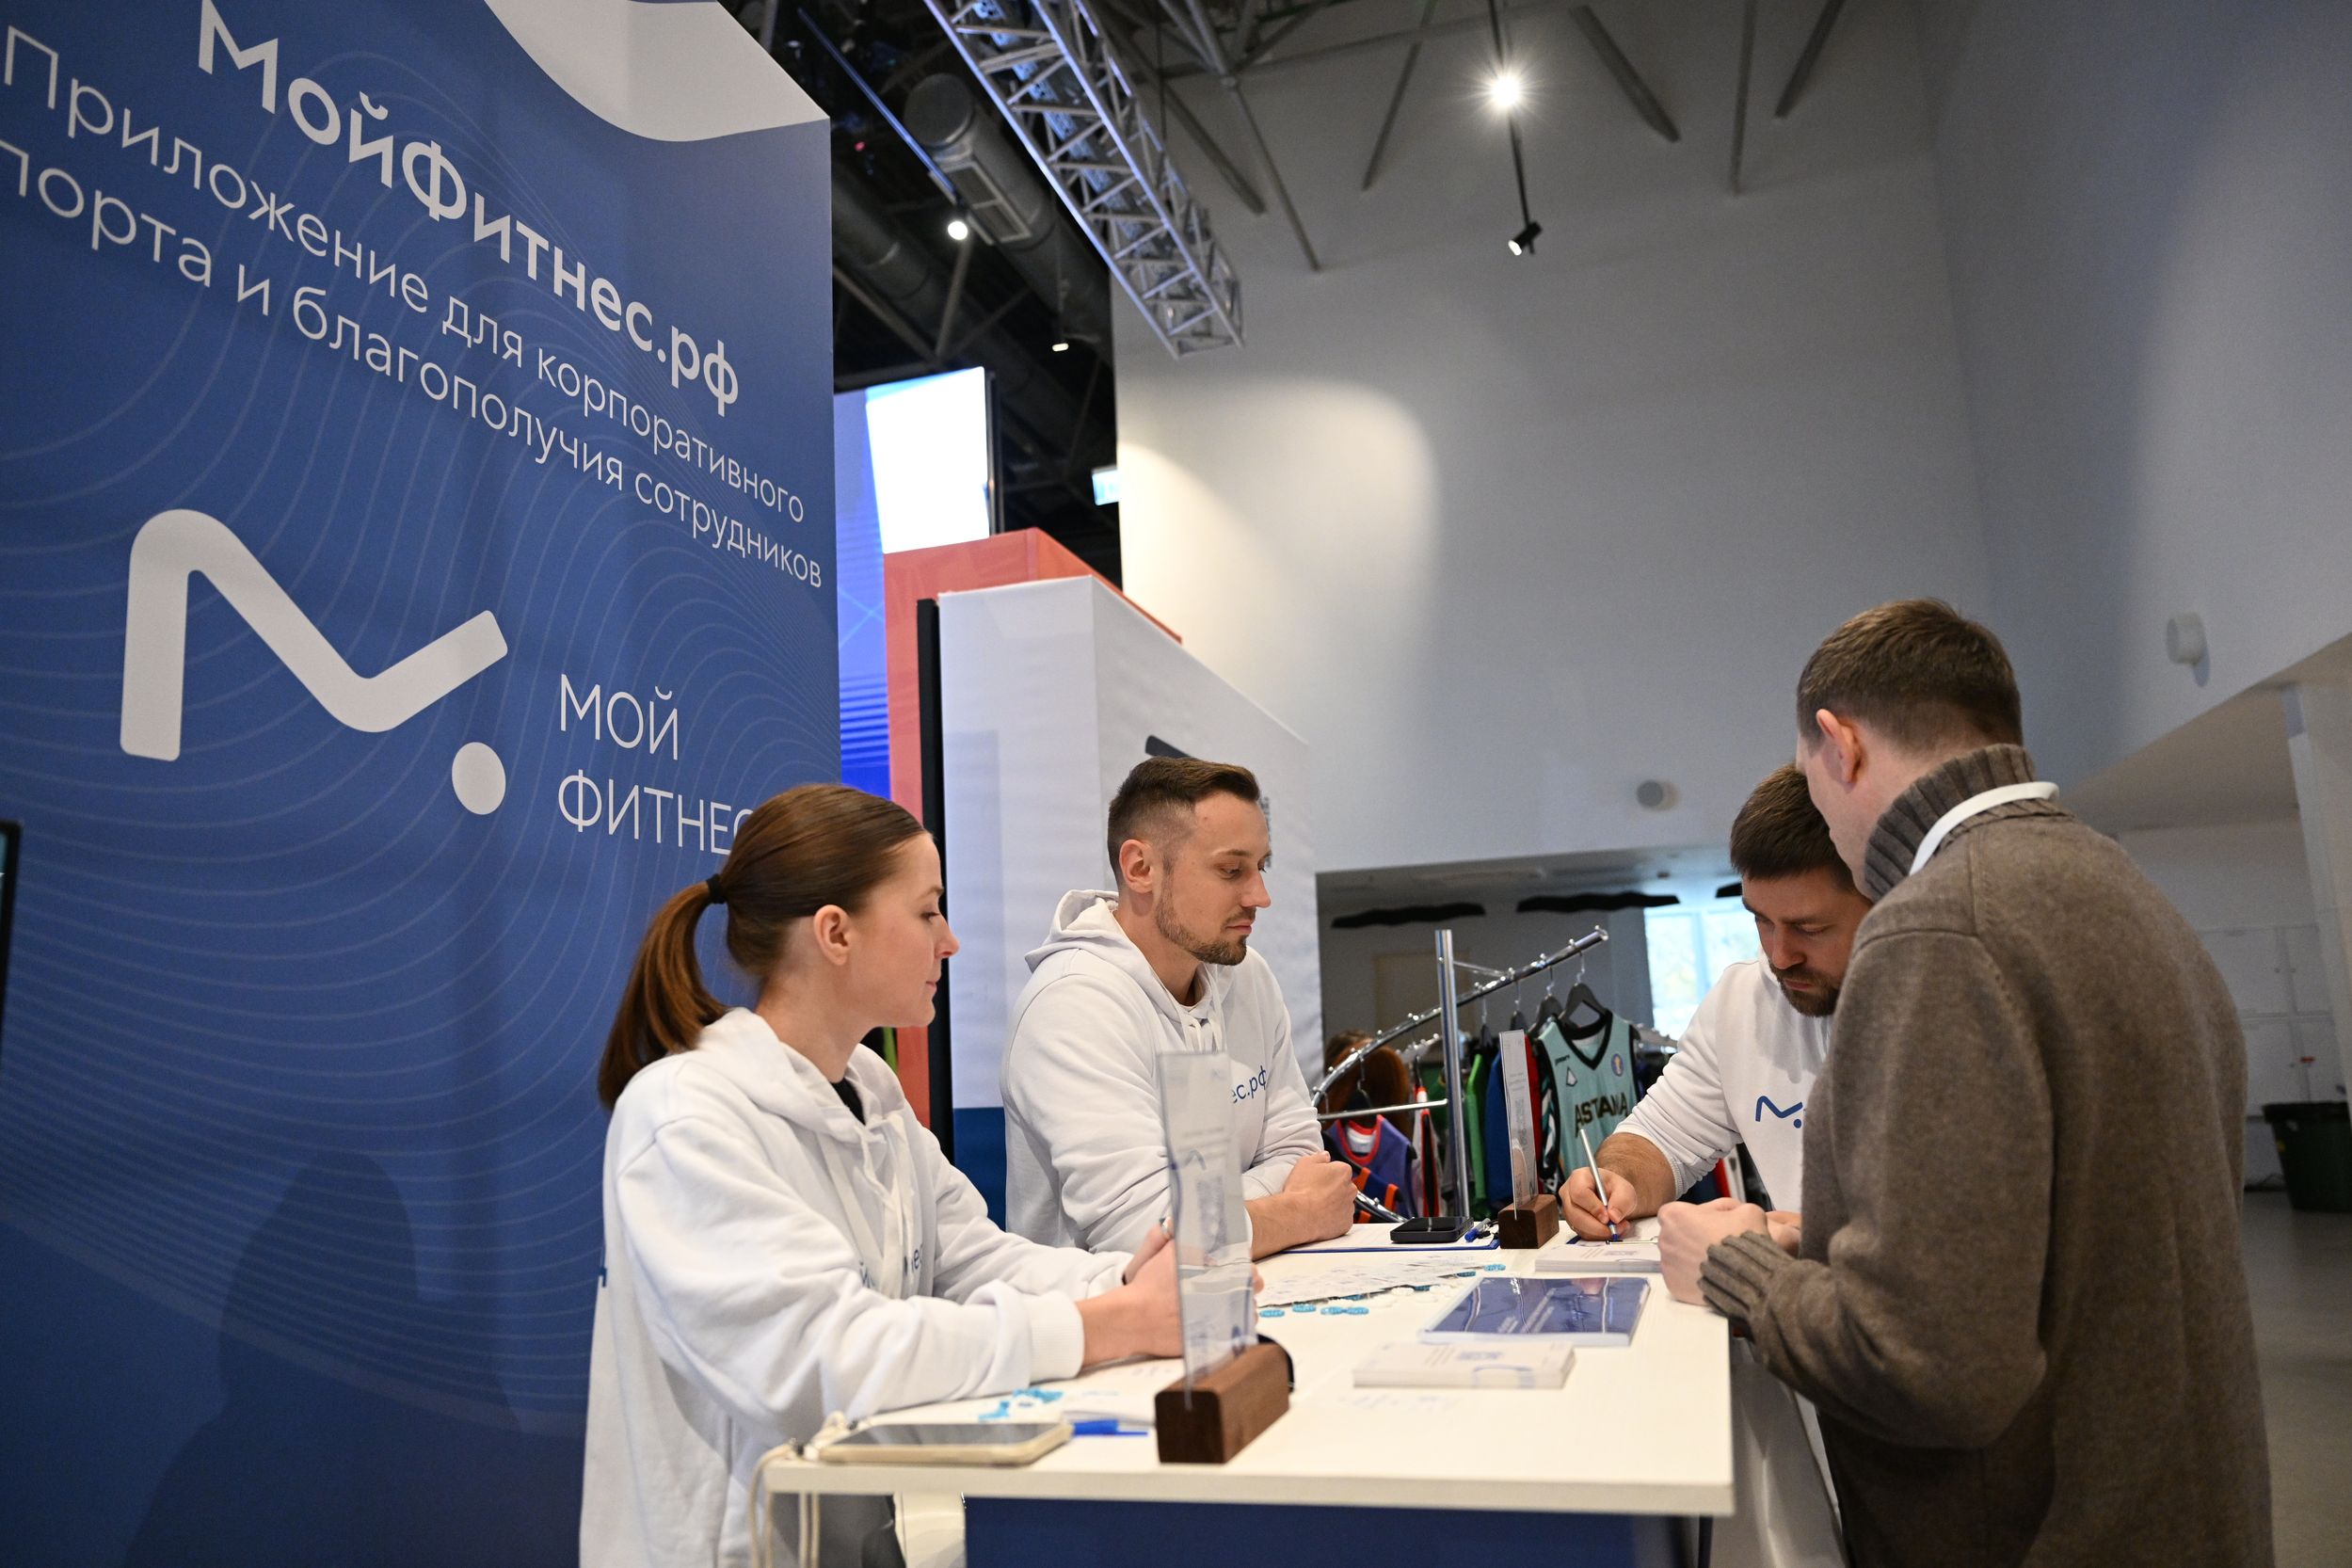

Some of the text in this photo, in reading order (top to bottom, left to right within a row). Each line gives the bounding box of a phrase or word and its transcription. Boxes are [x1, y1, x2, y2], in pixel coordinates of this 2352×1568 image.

[5, 25, 804, 523] Приложение для корпоративного
[199, 0, 739, 417] МойФитнес.рф
[237, 263, 270, 316] и
[294, 285, 623, 491] благополучия
[635, 472, 822, 588] сотрудников
[560, 673, 679, 760] МОЙ
